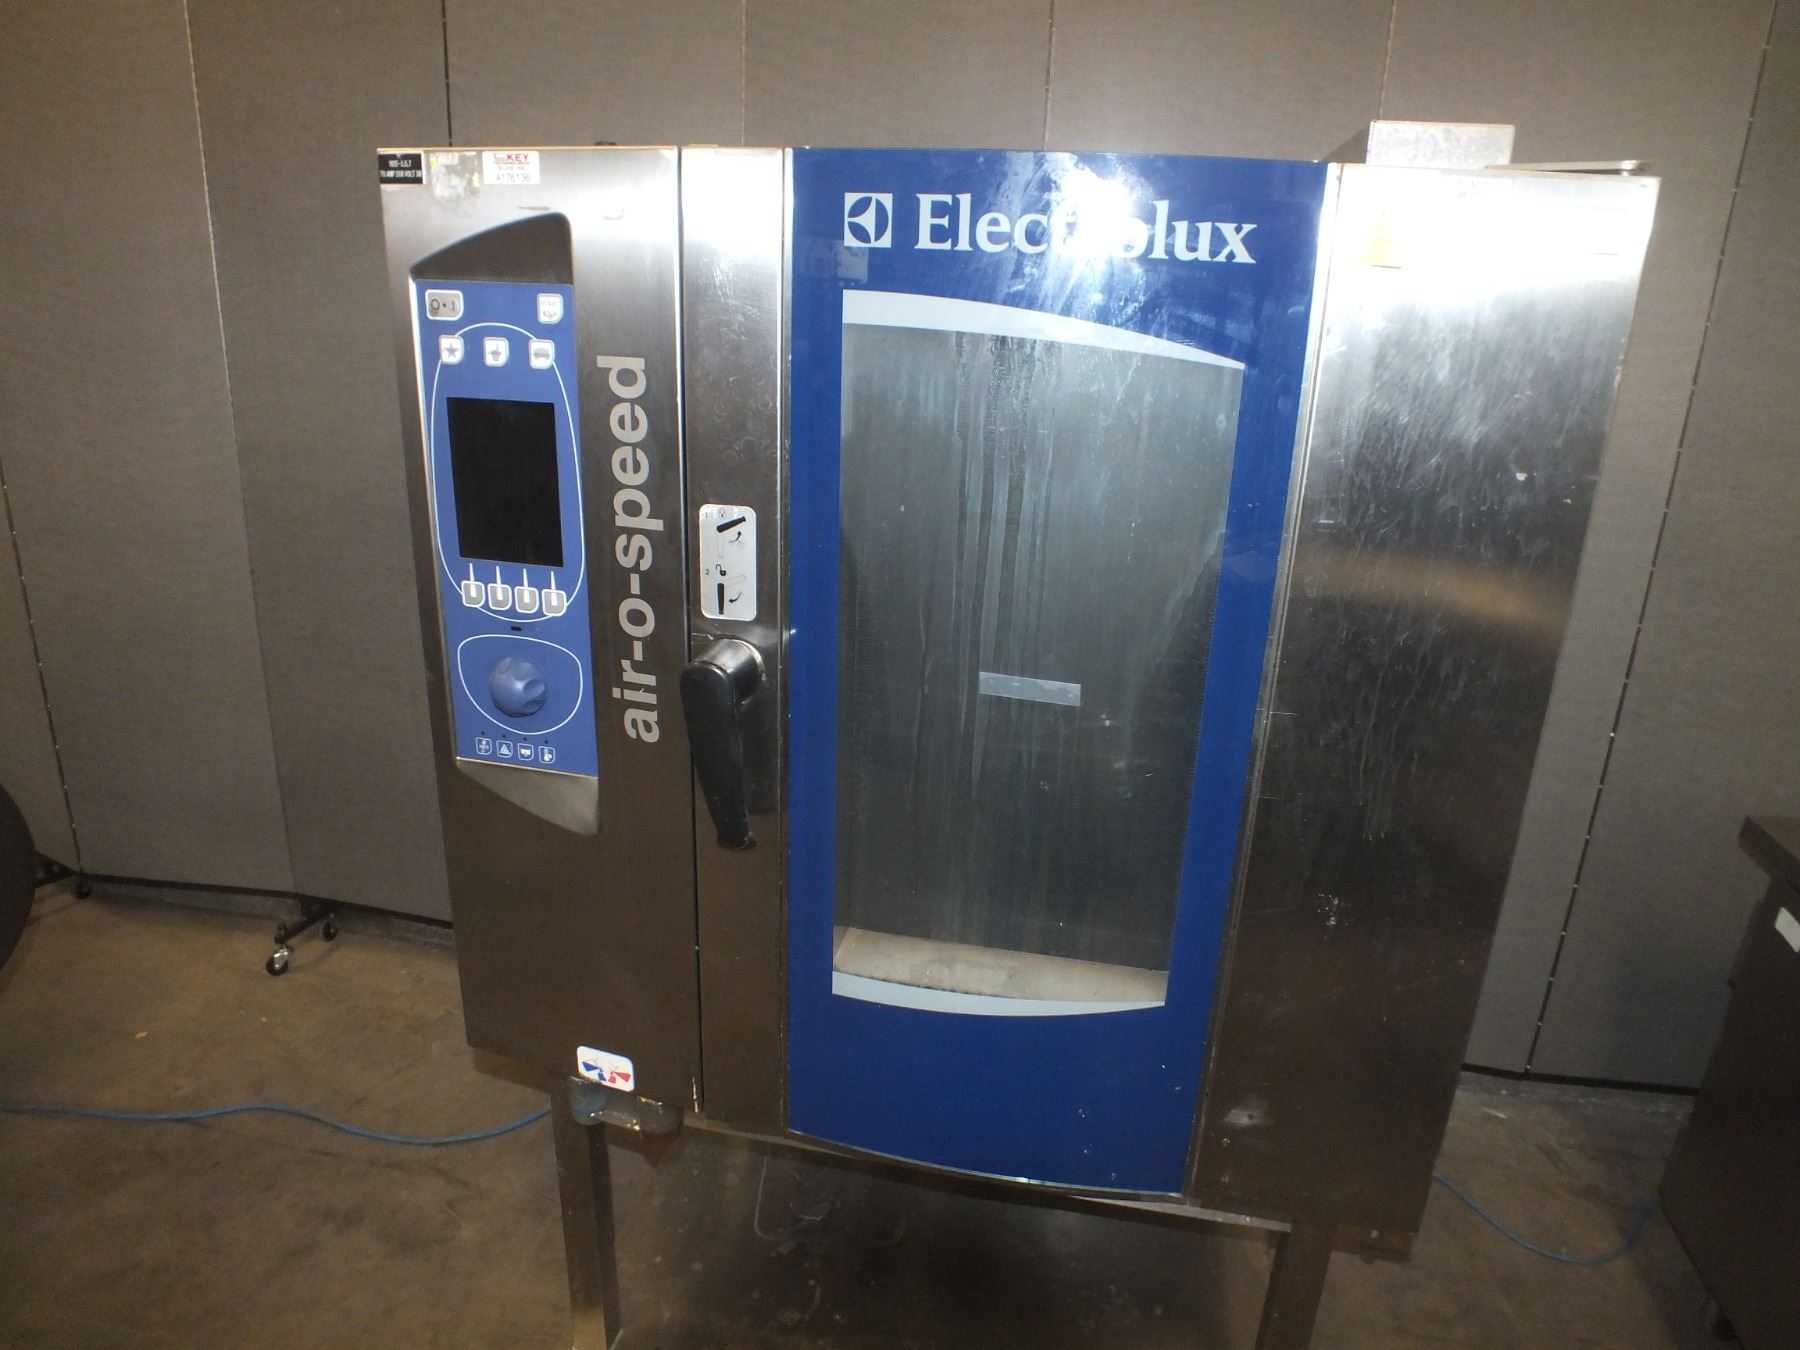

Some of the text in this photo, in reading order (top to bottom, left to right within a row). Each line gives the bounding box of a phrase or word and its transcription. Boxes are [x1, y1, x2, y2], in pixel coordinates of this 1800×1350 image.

[506, 153, 529, 162] KEY
[914, 192, 1257, 265] Elecolux
[597, 355, 664, 744] air-o-speed
